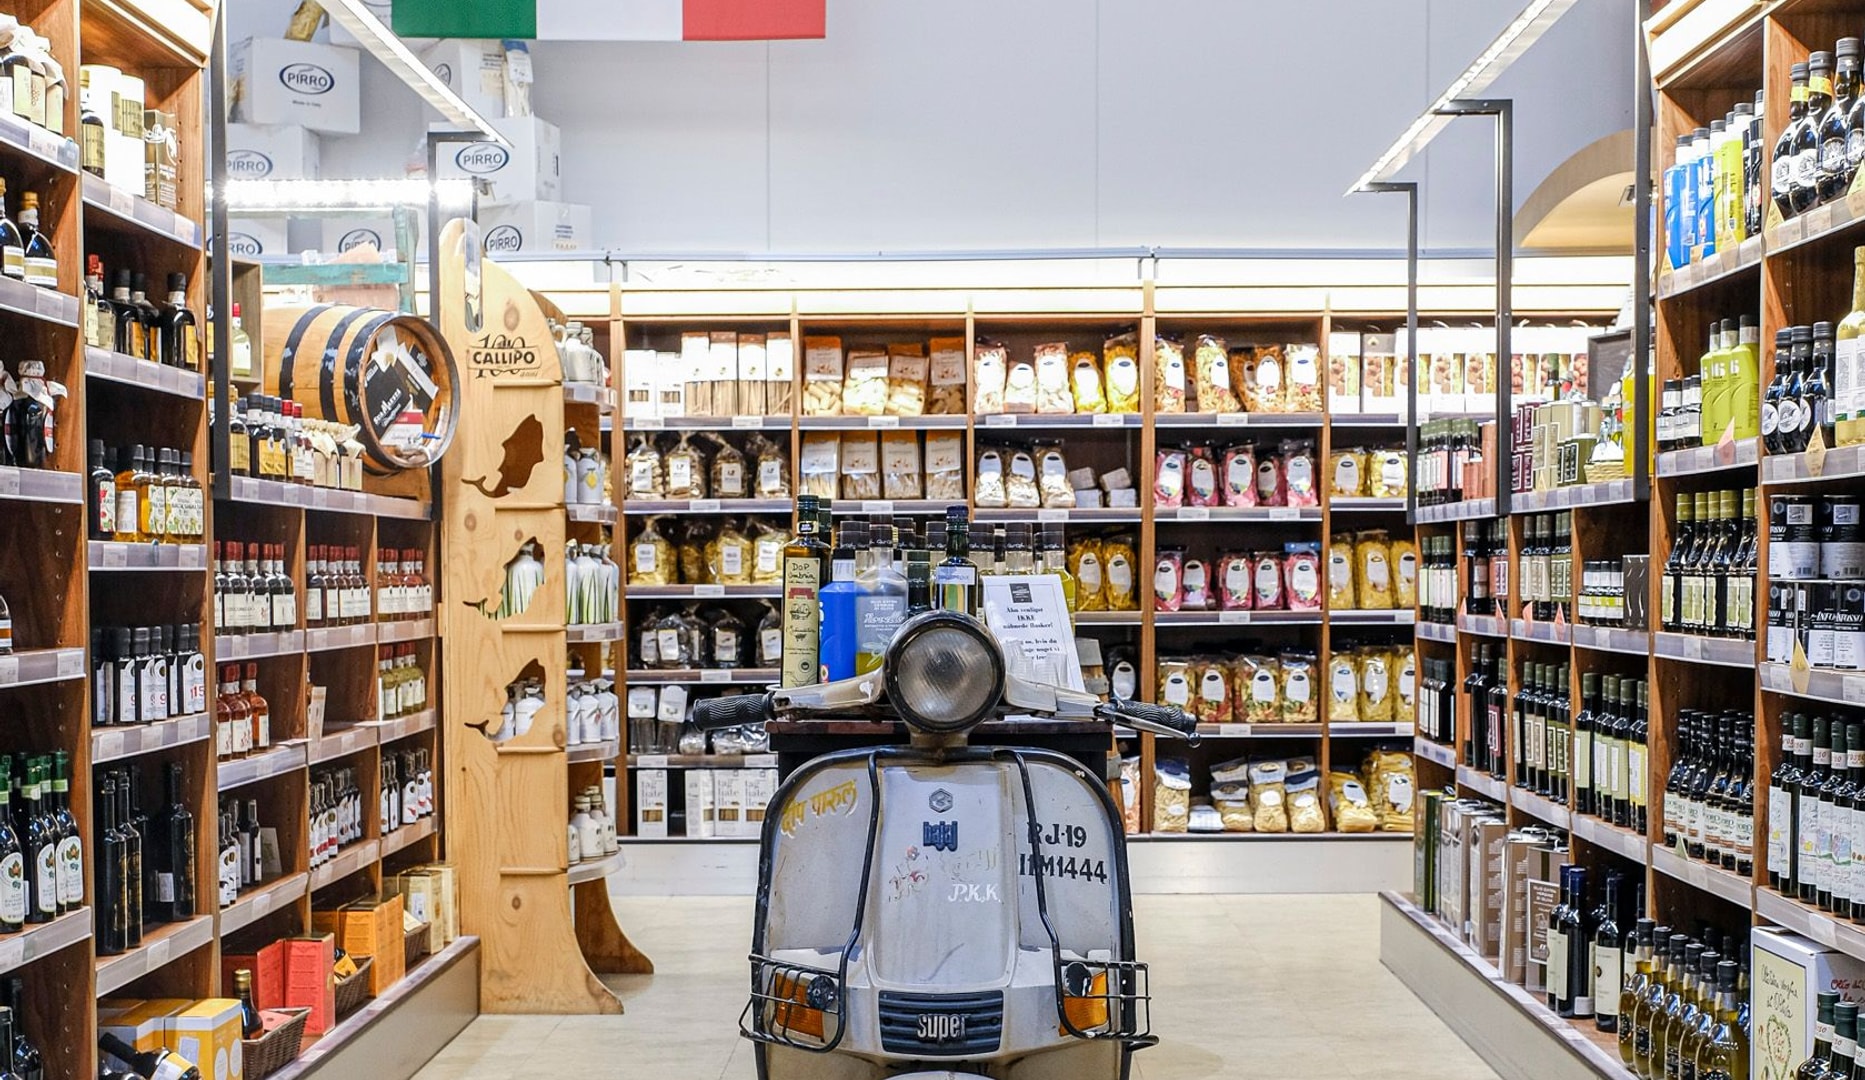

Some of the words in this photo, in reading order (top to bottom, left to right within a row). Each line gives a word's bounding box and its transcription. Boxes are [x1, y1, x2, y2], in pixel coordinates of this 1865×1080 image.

[287, 72, 328, 88] PIRRO
[463, 152, 503, 166] PIRRO
[228, 243, 256, 254] RRO
[489, 235, 518, 251] PIRRO
[473, 350, 536, 365] CALLIPO
[791, 562, 810, 572] DOP
[917, 1013, 970, 1043] super
